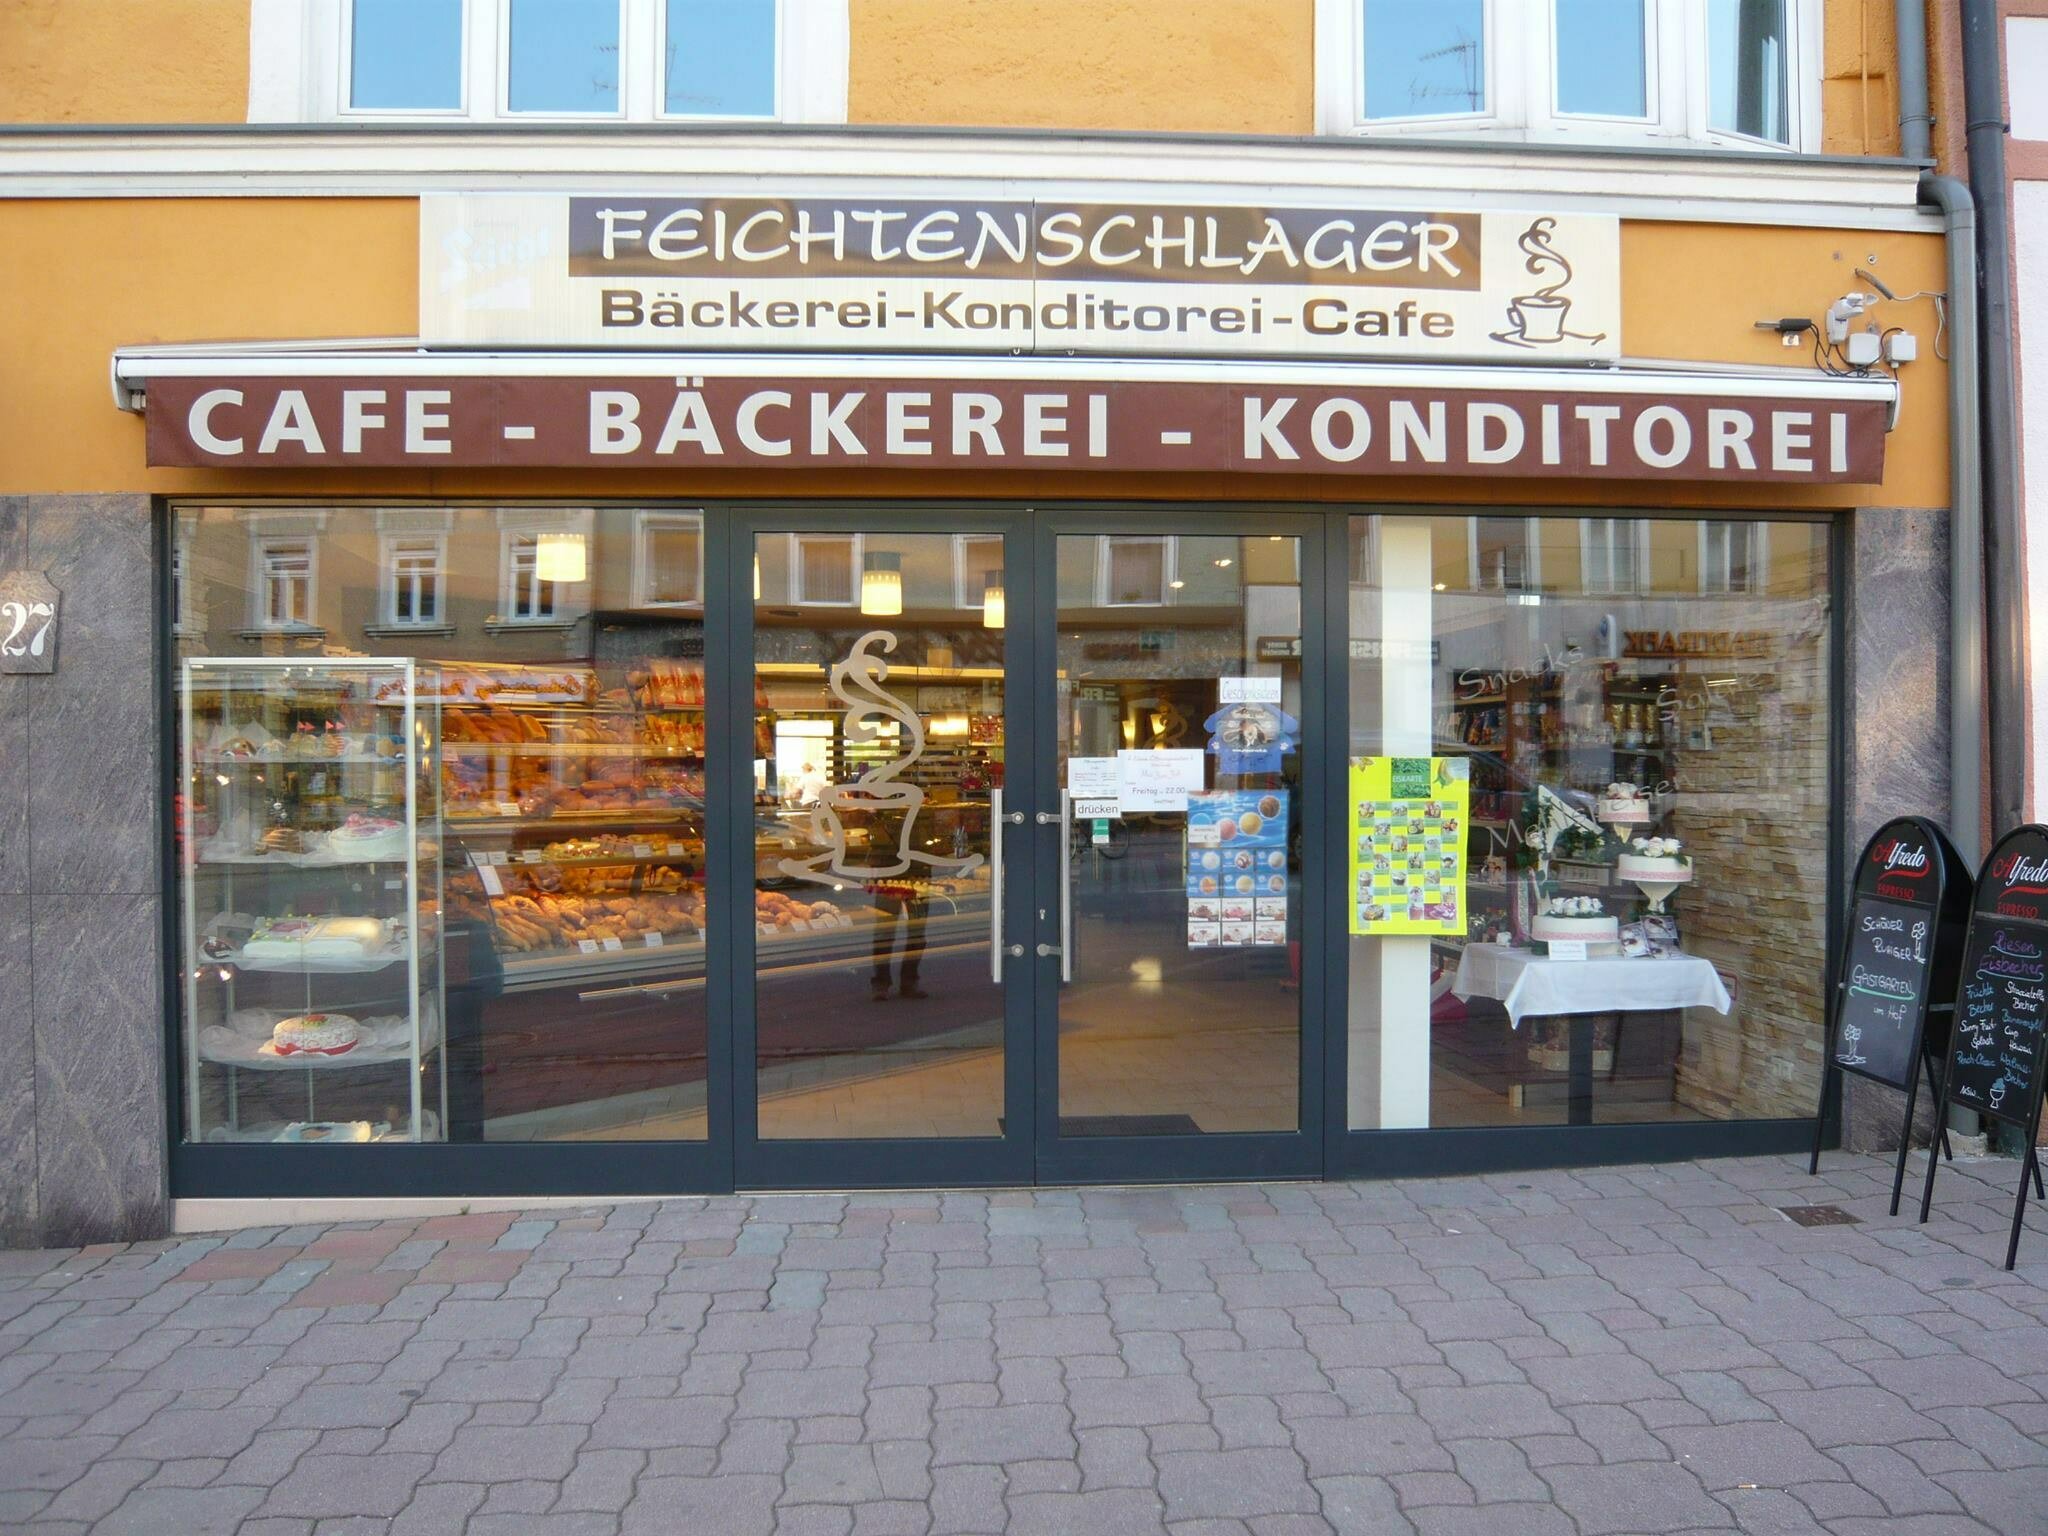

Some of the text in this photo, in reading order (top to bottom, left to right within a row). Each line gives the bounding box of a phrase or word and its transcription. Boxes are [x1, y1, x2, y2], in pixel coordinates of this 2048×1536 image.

[595, 208, 1462, 280] FEICHTENSCHLAGER
[188, 389, 452, 455] CAFE
[589, 377, 1107, 457] BÄCKEREI
[1243, 397, 1848, 473] KONDITOREI
[1, 601, 55, 657] 27
[1459, 643, 1583, 700] Snacks
[1132, 787, 1160, 796] Freitag
[1078, 804, 1119, 814] drücken
[1872, 838, 1926, 870] Alfredo
[1992, 852, 2048, 886] Alfredo
[1877, 882, 1916, 900] ESPRESSO
[1997, 902, 2039, 920] ESPRESSO
